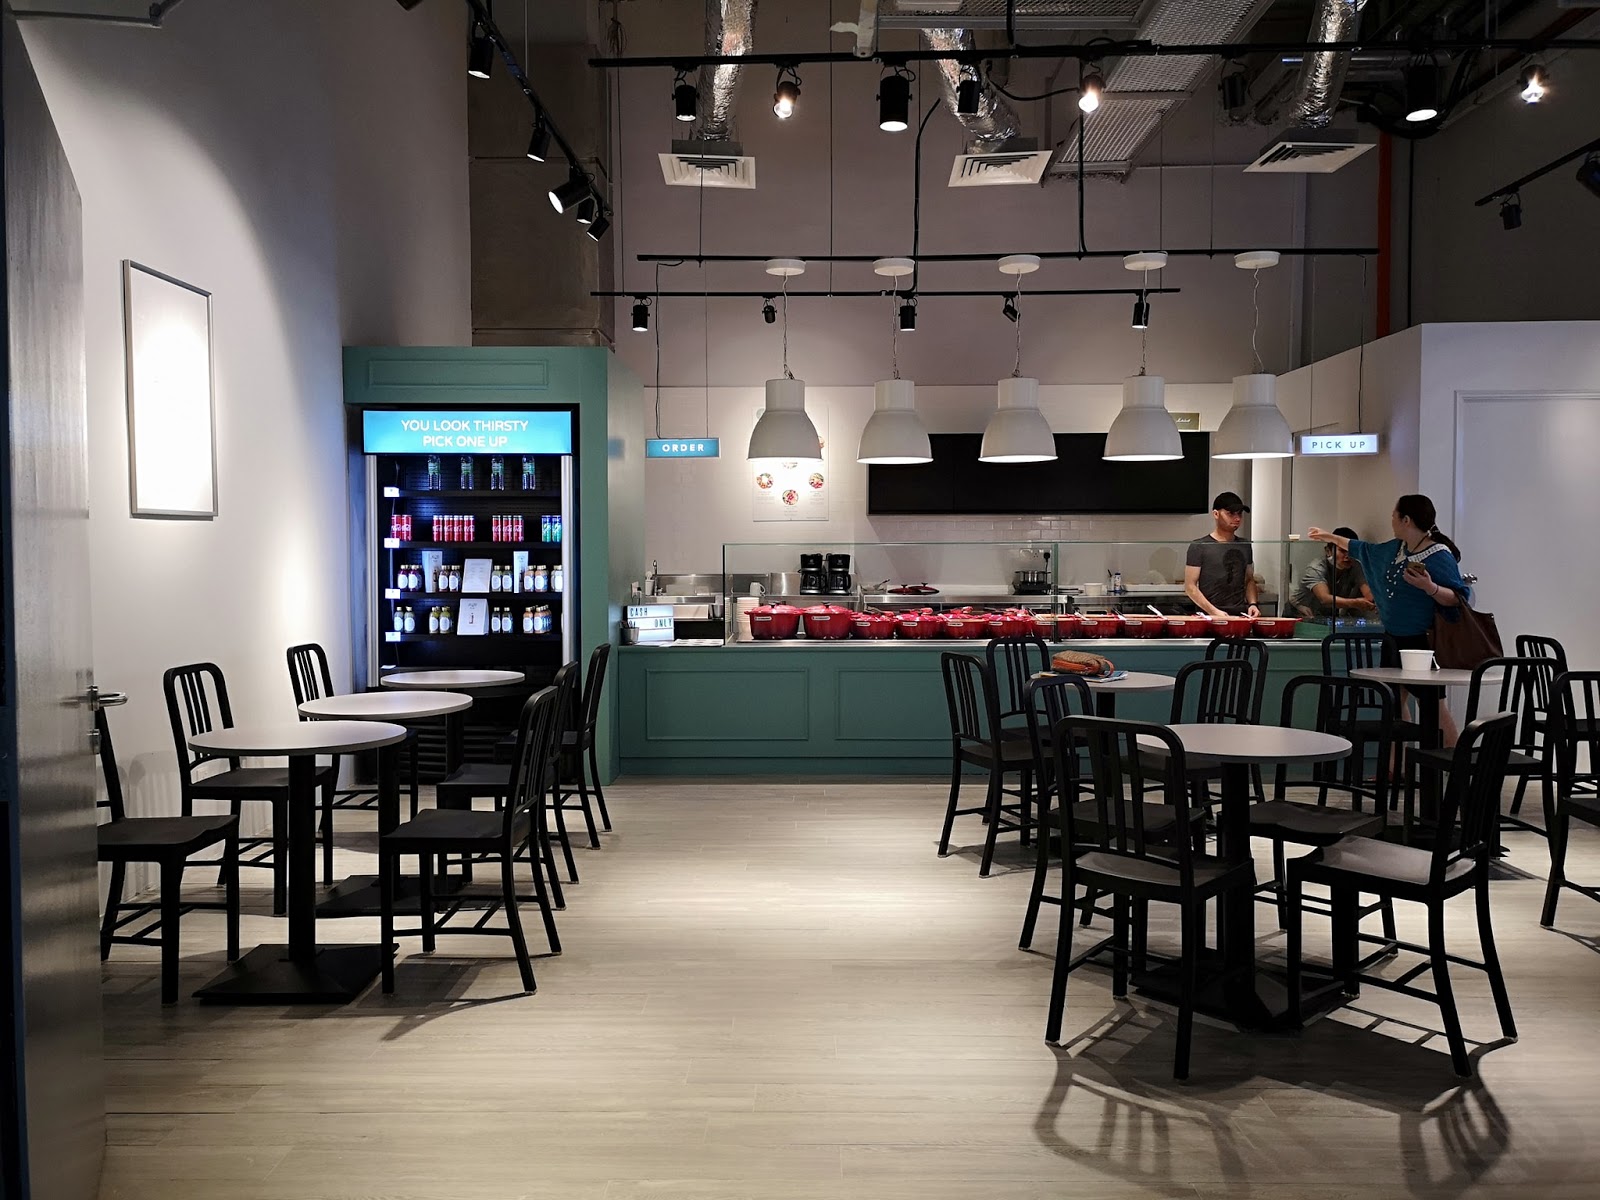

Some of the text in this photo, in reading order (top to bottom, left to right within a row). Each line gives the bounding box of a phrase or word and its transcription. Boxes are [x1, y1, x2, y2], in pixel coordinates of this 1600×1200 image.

[401, 419, 529, 432] YOU LOOK THIRSTY
[423, 435, 509, 447] PICK ONE UP
[1311, 441, 1366, 449] PICK UP
[661, 443, 705, 452] ORDER
[630, 607, 648, 617] CASH
[654, 618, 673, 628] ONLY
